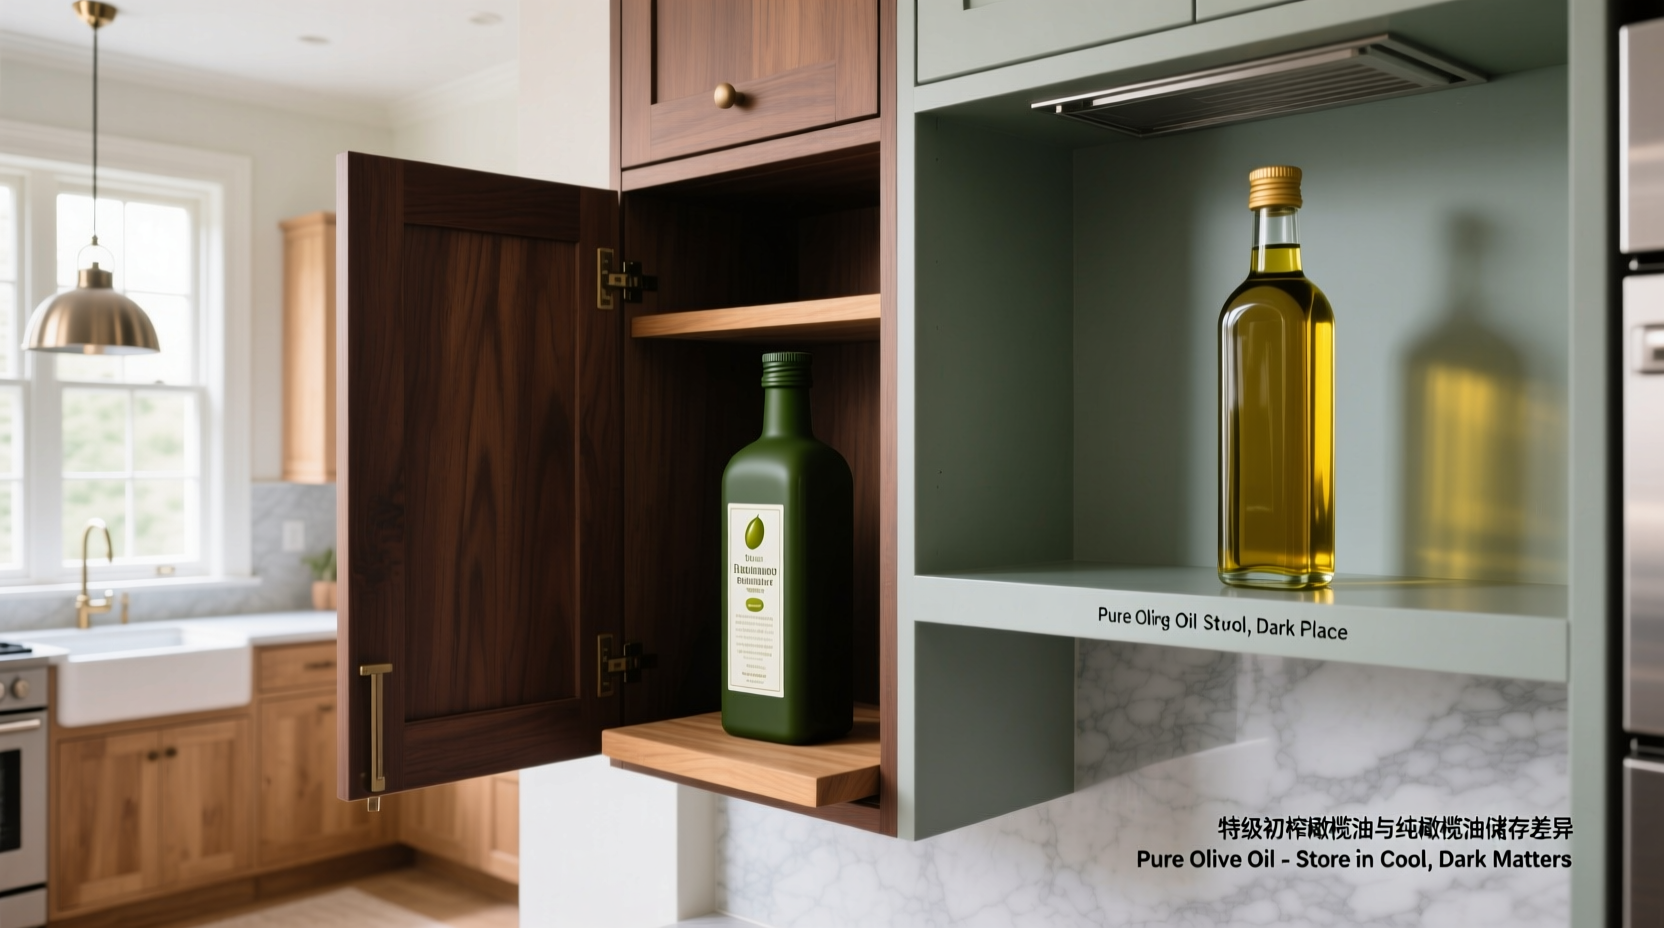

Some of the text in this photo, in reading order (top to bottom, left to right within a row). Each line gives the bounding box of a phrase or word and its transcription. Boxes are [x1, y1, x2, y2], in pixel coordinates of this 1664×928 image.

[1098, 607, 1131, 624] Pure
[1175, 612, 1197, 630] Oil
[1256, 618, 1295, 637] Dark
[1300, 620, 1348, 641] Place
